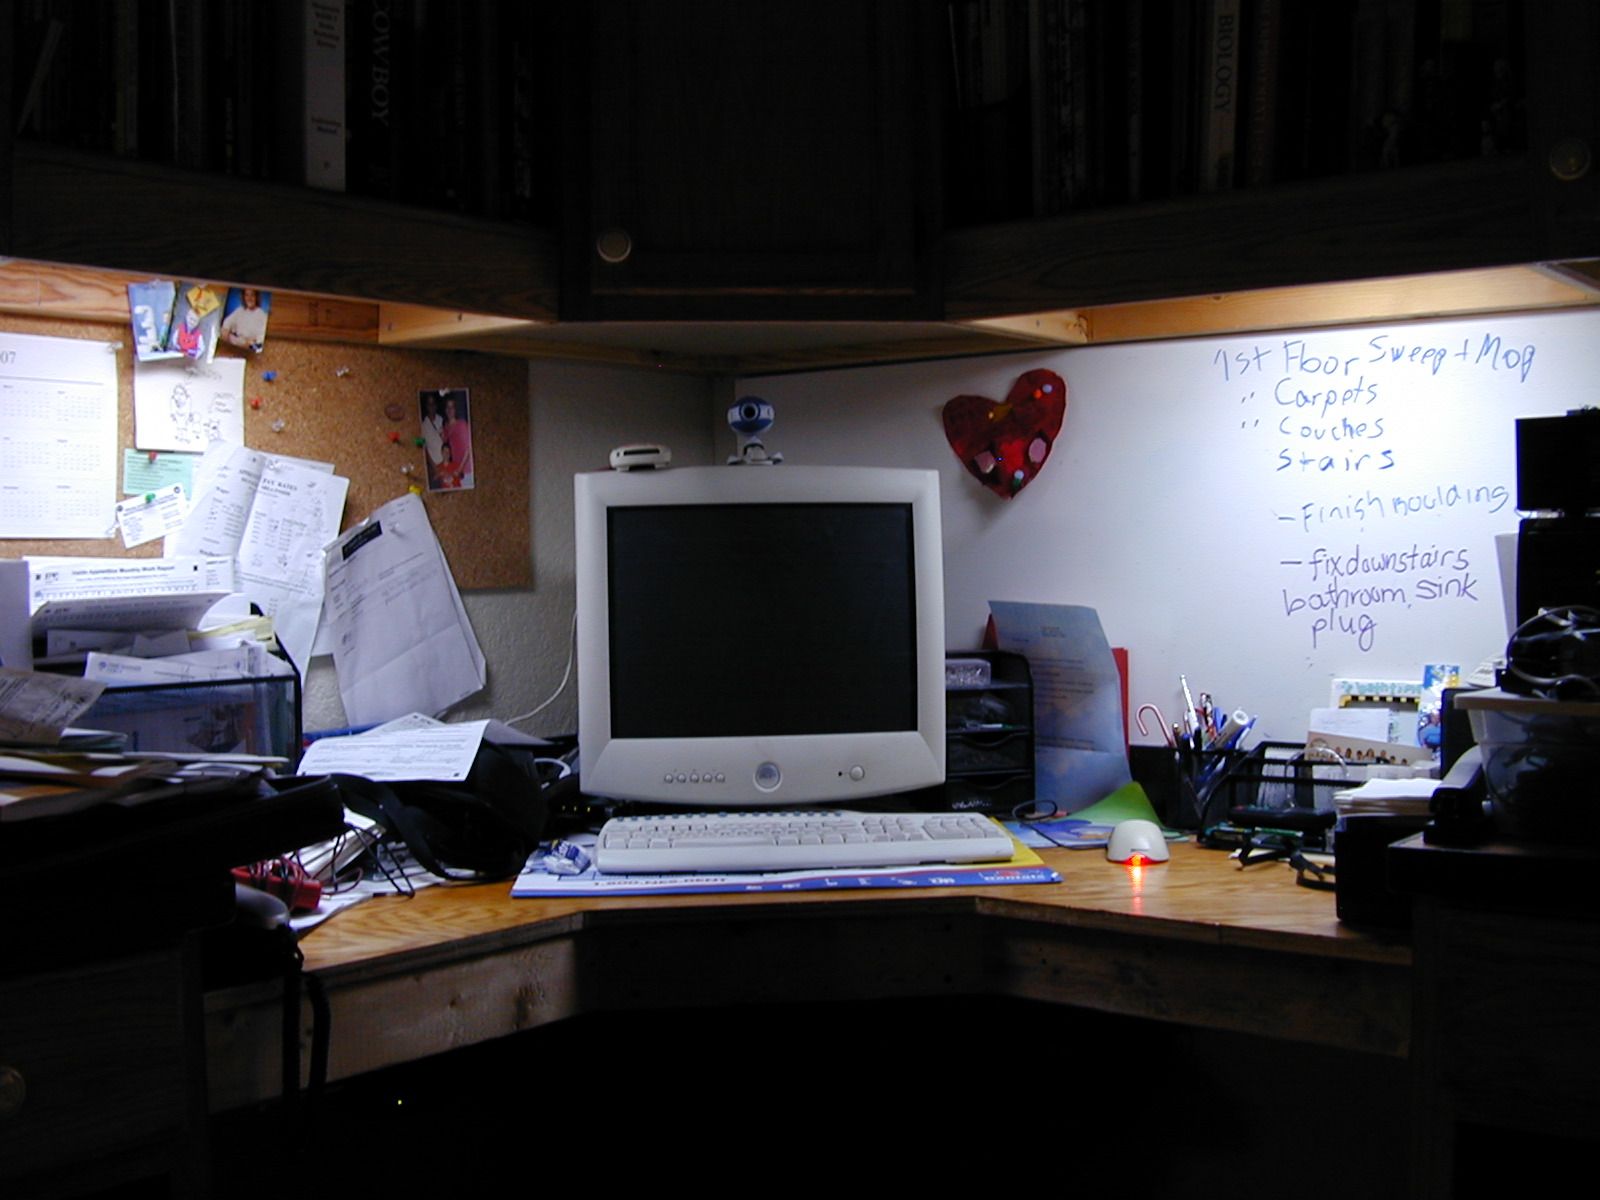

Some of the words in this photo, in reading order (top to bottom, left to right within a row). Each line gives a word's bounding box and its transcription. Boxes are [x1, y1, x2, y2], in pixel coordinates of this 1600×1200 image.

[1214, 15, 1234, 113] BIOLOGY
[1213, 345, 1272, 381] 1st
[1283, 340, 1359, 376] Floor
[1369, 335, 1447, 375] Sweep
[1274, 376, 1378, 417] Carpets
[1279, 416, 1384, 440] Couches
[1302, 490, 1385, 533] Finish
[1311, 607, 1377, 652] plug
